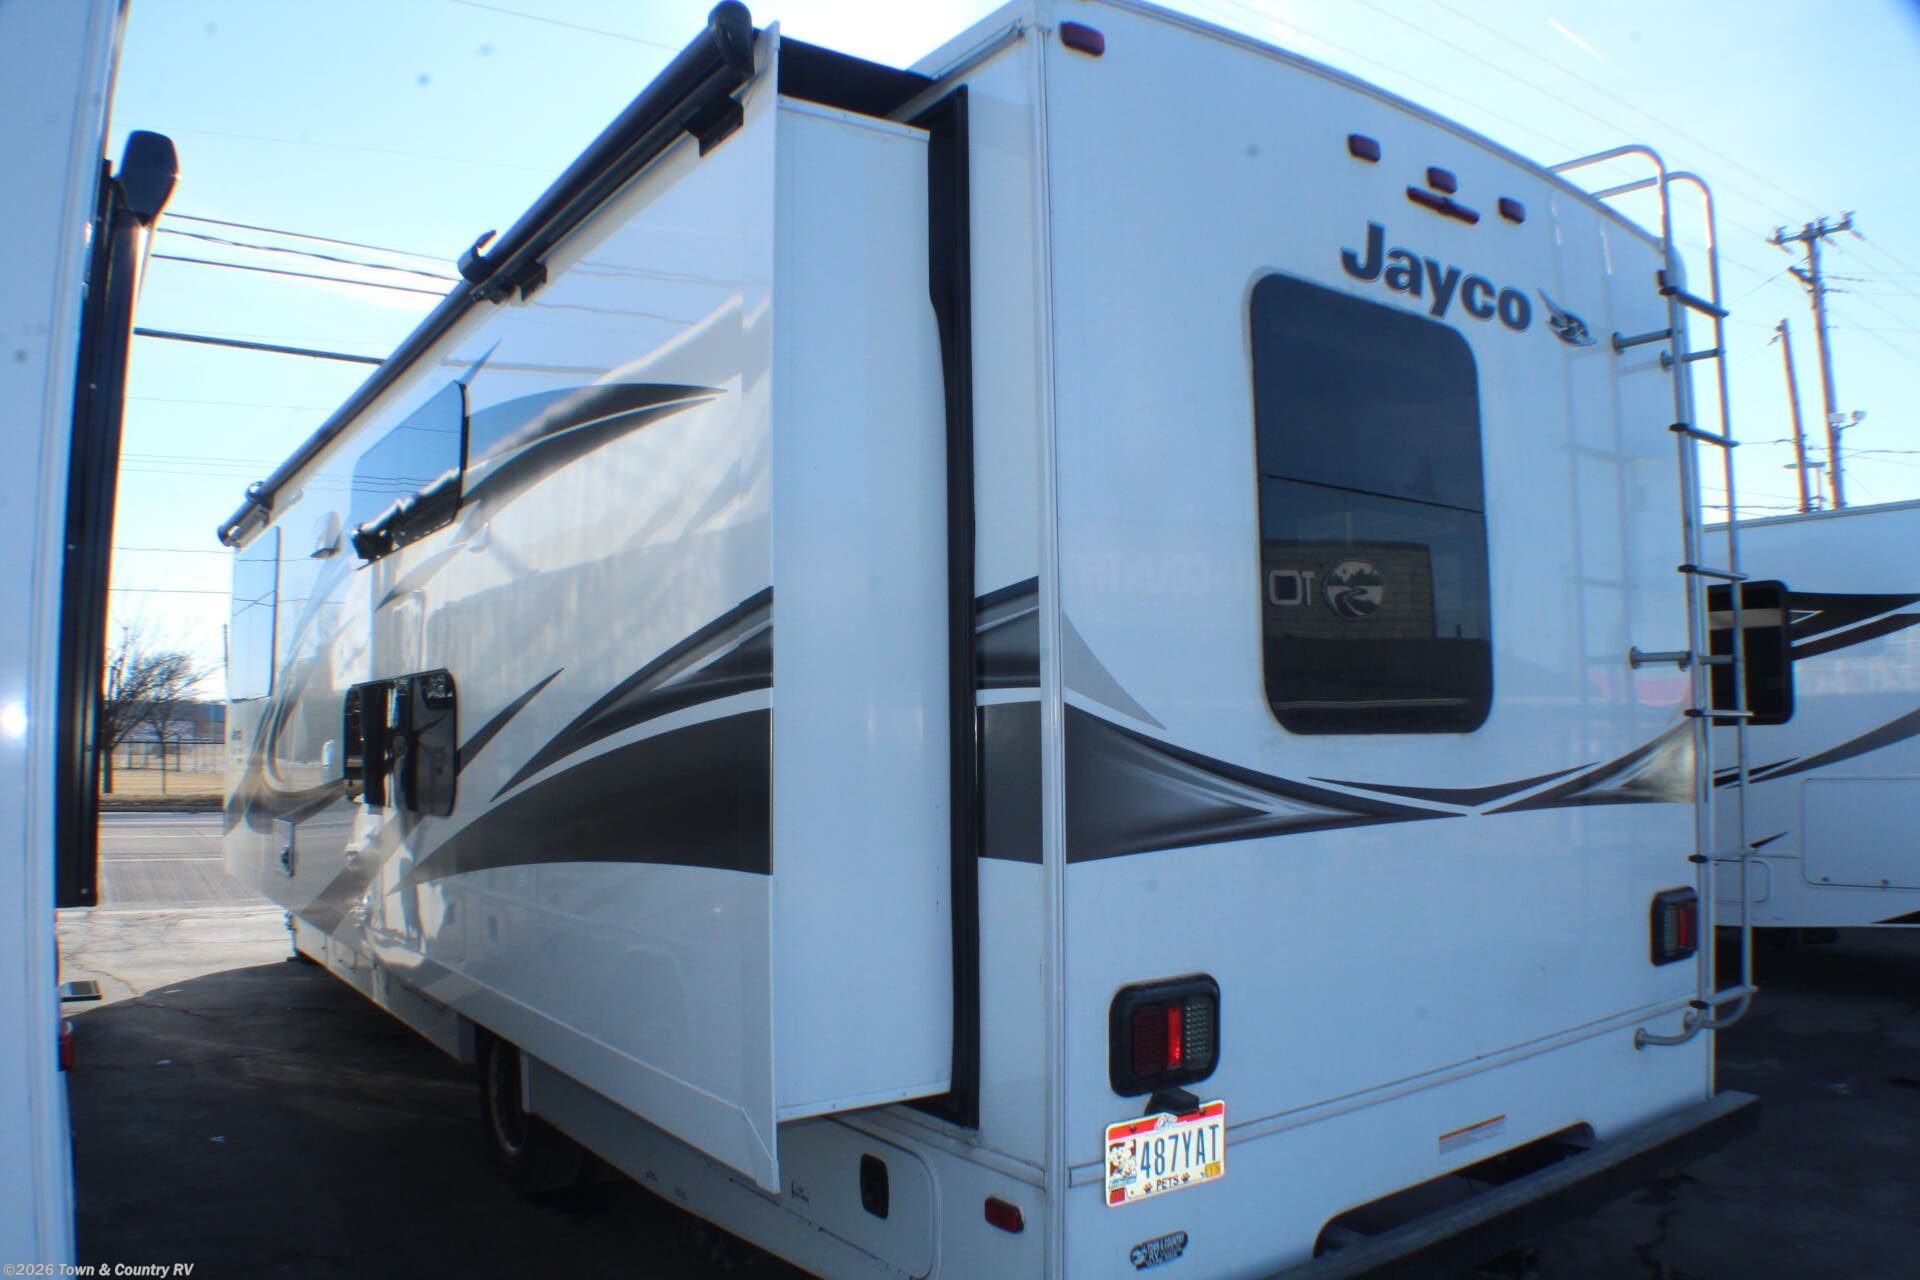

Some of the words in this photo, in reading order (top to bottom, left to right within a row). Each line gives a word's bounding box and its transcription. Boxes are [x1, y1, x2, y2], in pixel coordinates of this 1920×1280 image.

[1340, 220, 1533, 333] Jayco
[1140, 1124, 1220, 1179] 487YAT
[1156, 1176, 1180, 1191] PETS
